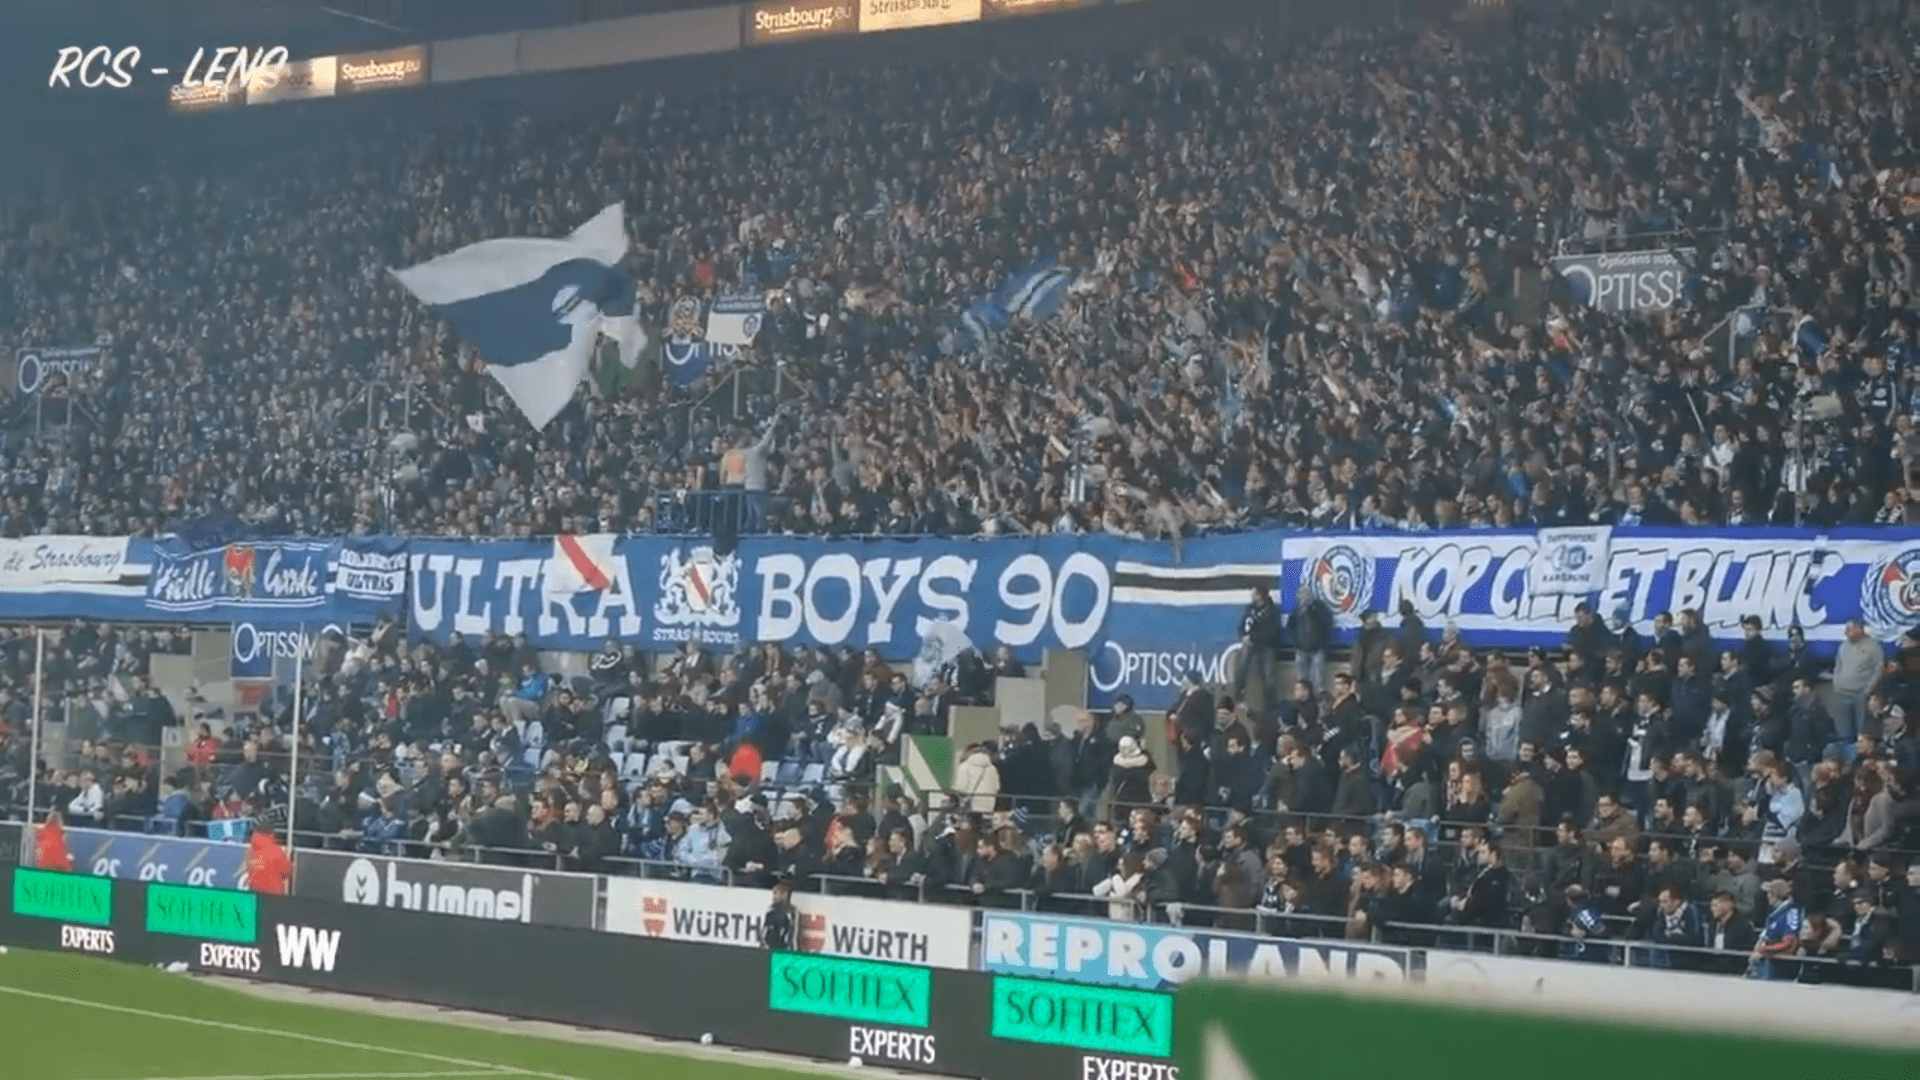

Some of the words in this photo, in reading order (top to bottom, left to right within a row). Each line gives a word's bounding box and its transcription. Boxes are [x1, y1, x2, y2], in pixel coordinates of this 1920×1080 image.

[29, 544, 123, 573] Strasbourg
[410, 552, 643, 638] ULTRA
[755, 552, 978, 644] BOYS
[994, 551, 1111, 648] 90
[1387, 543, 1492, 620] KOP
[1599, 548, 1668, 625] ET
[1668, 548, 1846, 631] BLANC
[234, 622, 344, 663] OPTISSIM
[385, 860, 533, 924] hummel
[61, 925, 115, 953] EXPERTS
[200, 943, 261, 973] EXPERTS
[986, 918, 1405, 983] REPROLAND
[850, 1026, 936, 1064] EXPERTS
